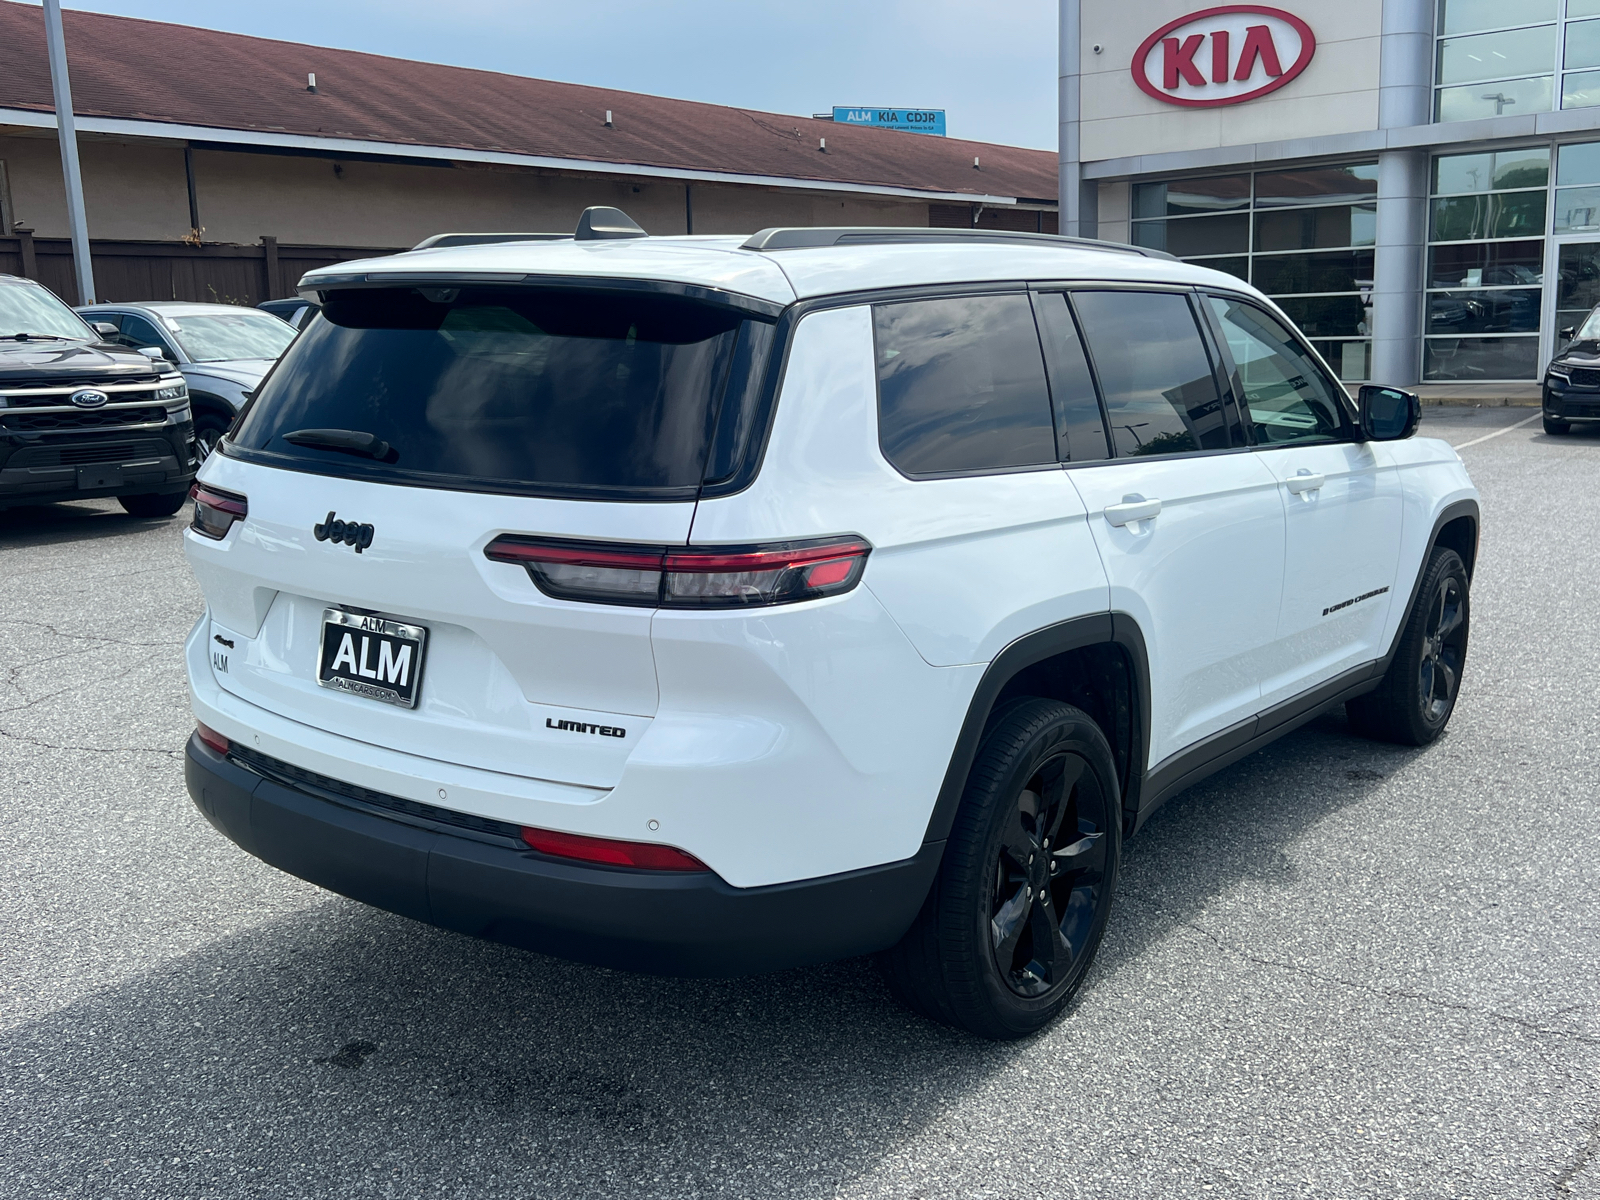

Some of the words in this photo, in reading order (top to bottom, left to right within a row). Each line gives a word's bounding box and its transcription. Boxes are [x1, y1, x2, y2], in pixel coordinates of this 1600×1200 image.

[1162, 25, 1283, 89] KIA
[847, 111, 872, 122] ALM
[878, 112, 898, 122] KIA
[906, 112, 935, 123] CDJR
[360, 616, 386, 634] ALM
[213, 651, 229, 674] ALM
[331, 632, 412, 687] ALM
[545, 717, 626, 738] LIMITED
